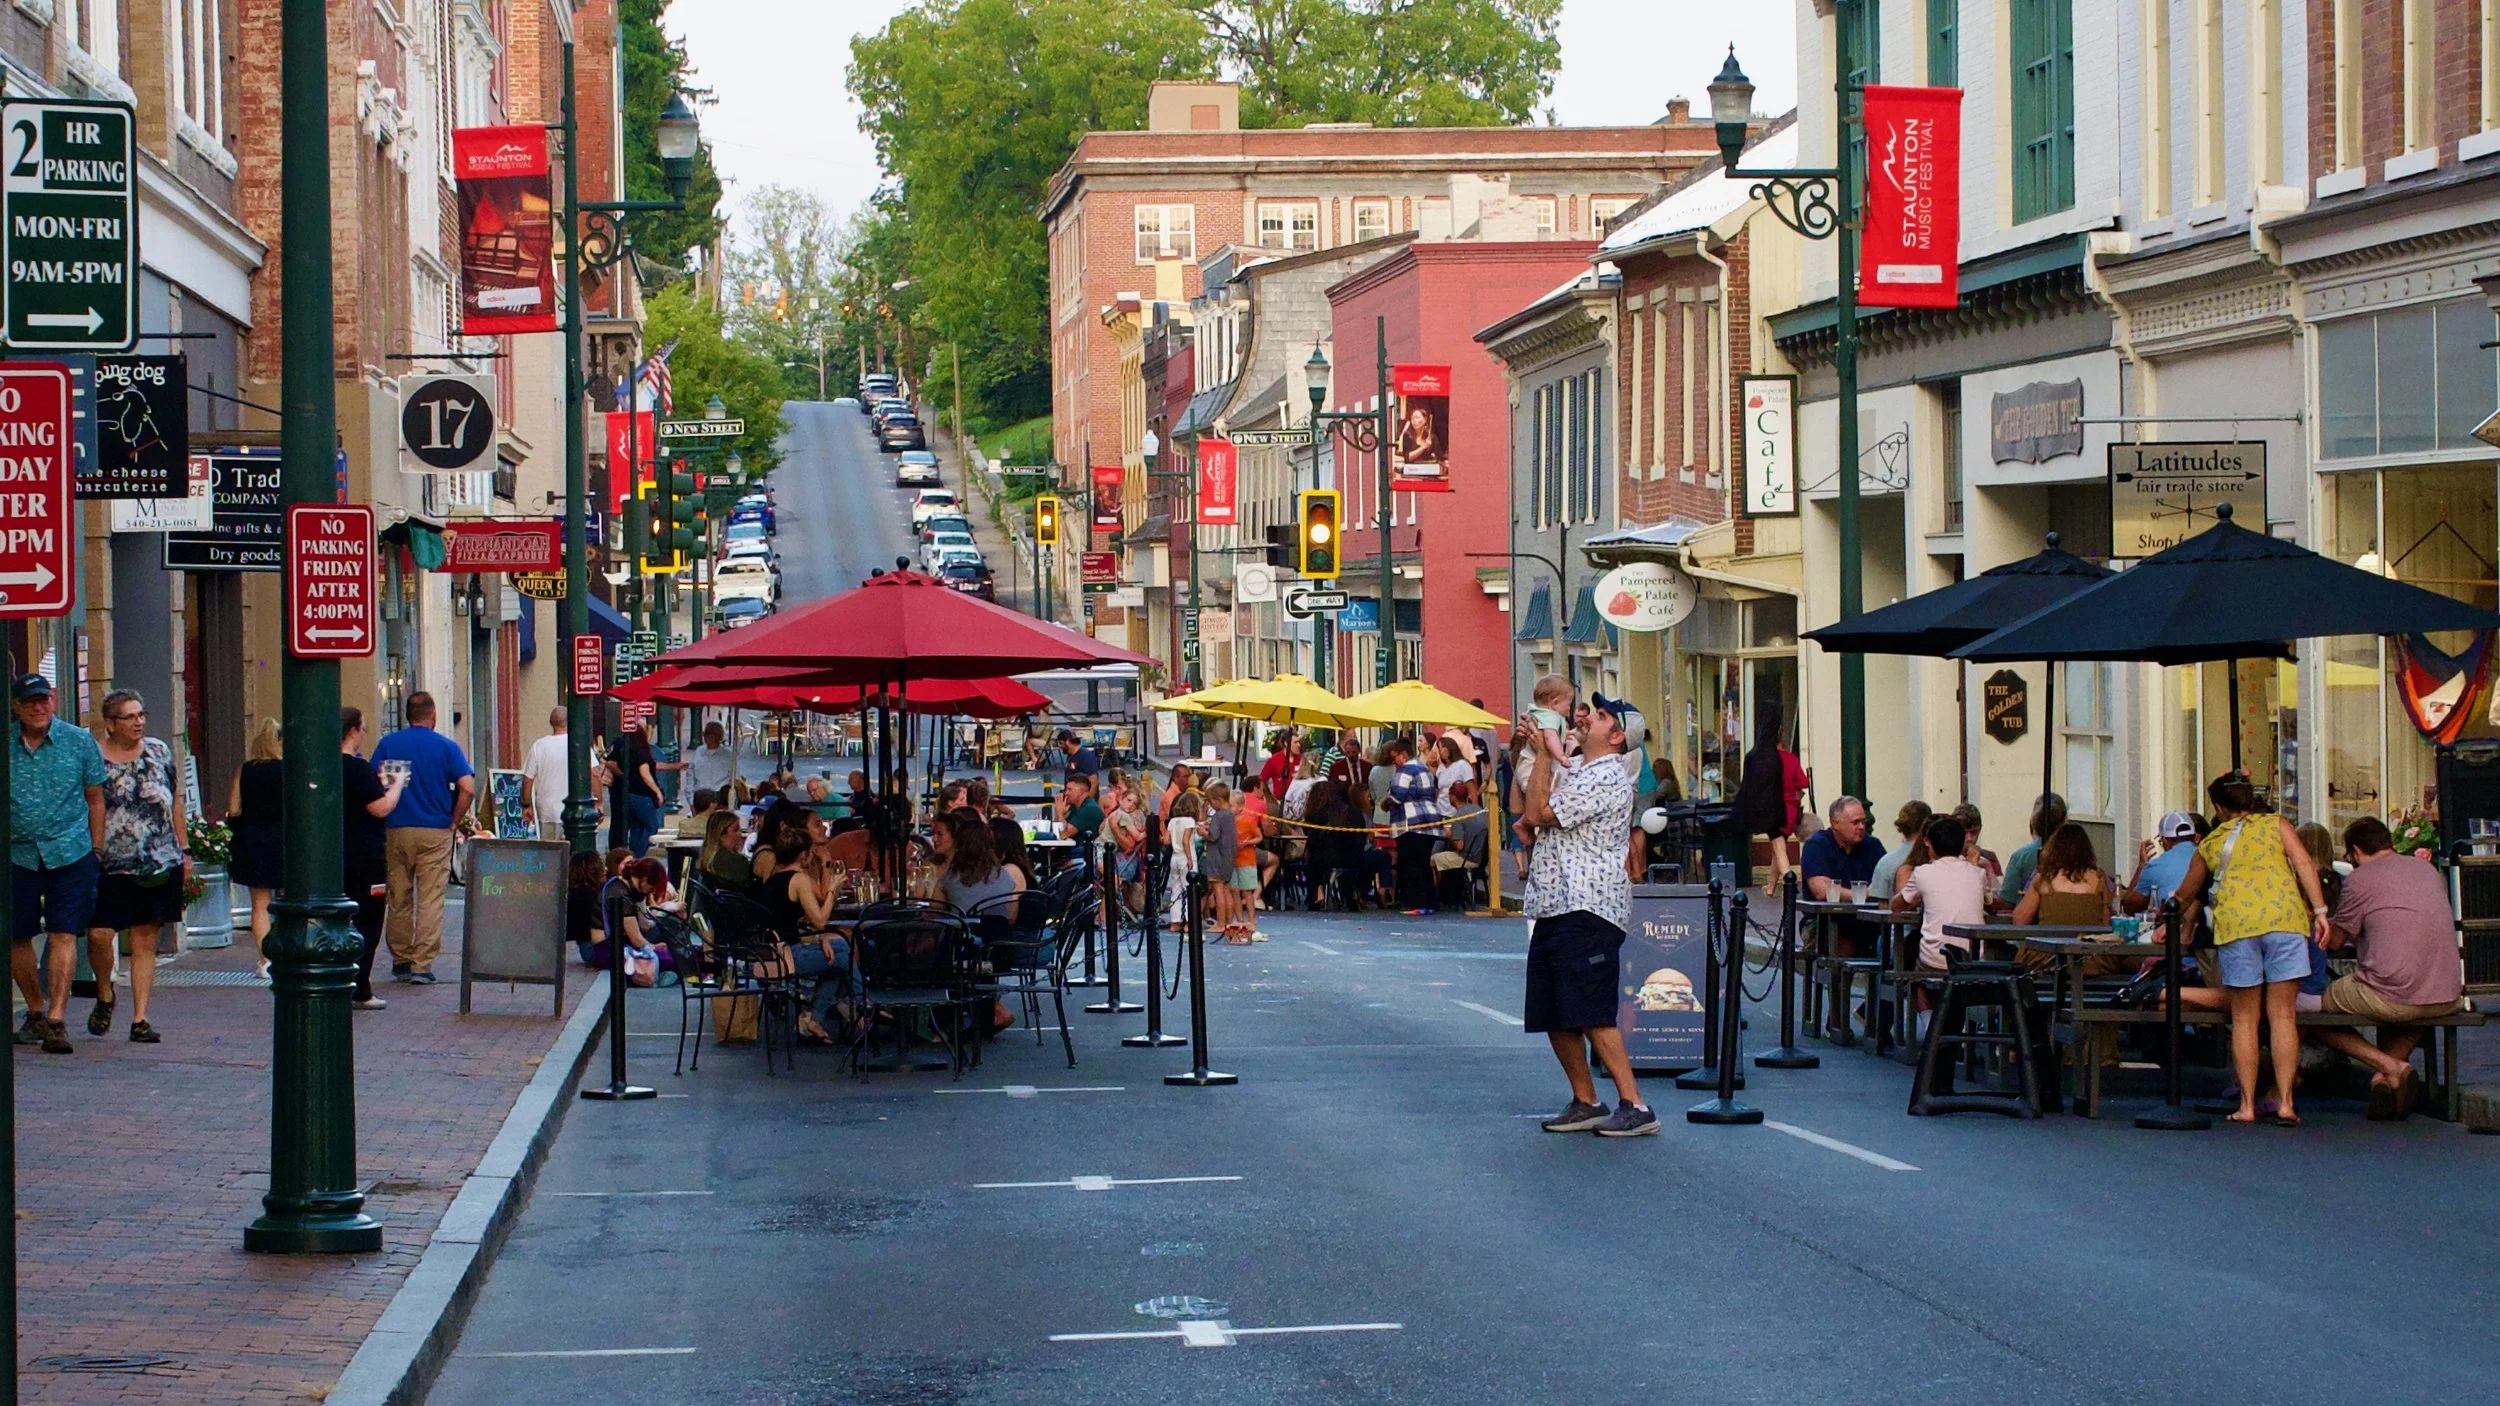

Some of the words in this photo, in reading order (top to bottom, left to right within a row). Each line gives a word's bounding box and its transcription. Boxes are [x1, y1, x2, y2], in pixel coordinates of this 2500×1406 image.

[65, 121, 102, 144] HR
[10, 119, 40, 177] 2
[1919, 118, 1934, 191] FESTIVAL
[468, 155, 532, 164] STAUNTON
[496, 161, 532, 170] FESTIVAL
[44, 158, 125, 183] PARKING
[1902, 119, 1919, 248] STAUNTON
[14, 215, 122, 240] MON-FRI
[1919, 197, 1933, 249] MUSIC
[11, 260, 123, 284] 9AM-5PM
[133, 361, 165, 386] dog
[0, 387, 22, 413] O
[420, 397, 476, 450] 17
[0, 421, 55, 446] KING
[2135, 449, 2243, 472] Latitudes
[0, 457, 53, 481] DAY
[111, 466, 168, 478] cheese
[231, 467, 281, 488] Trad
[76, 481, 168, 492] harcuterie
[2136, 479, 2161, 493] fair
[2166, 479, 2203, 493] trade
[2208, 481, 2245, 493] store
[0, 493, 47, 517] TER
[212, 491, 281, 505] COMPANY
[214, 523, 231, 532] ine
[235, 523, 260, 535] gifts
[263, 524, 272, 533] &
[320, 519, 346, 535] NO
[301, 540, 364, 555] PARKING
[456, 536, 550, 551] SHENANDOAH
[2138, 534, 2174, 550] Shop
[210, 547, 234, 563] Dry
[240, 548, 281, 563] goods
[456, 551, 488, 561] PIZZA
[302, 560, 363, 576] FRIDAY
[517, 579, 553, 592] QUEEN
[1620, 574, 1676, 587] Pampered
[307, 582, 360, 598] AFTER
[1645, 590, 1679, 601] Palate
[303, 603, 364, 619] 4:00PM
[1648, 604, 1675, 615] Café
[1987, 685, 2009, 695] THE
[1988, 691, 2024, 721] GOLDEN
[2001, 716, 2023, 728] TUB
[481, 875, 506, 896] For
[1642, 920, 1691, 937] REMEDY
